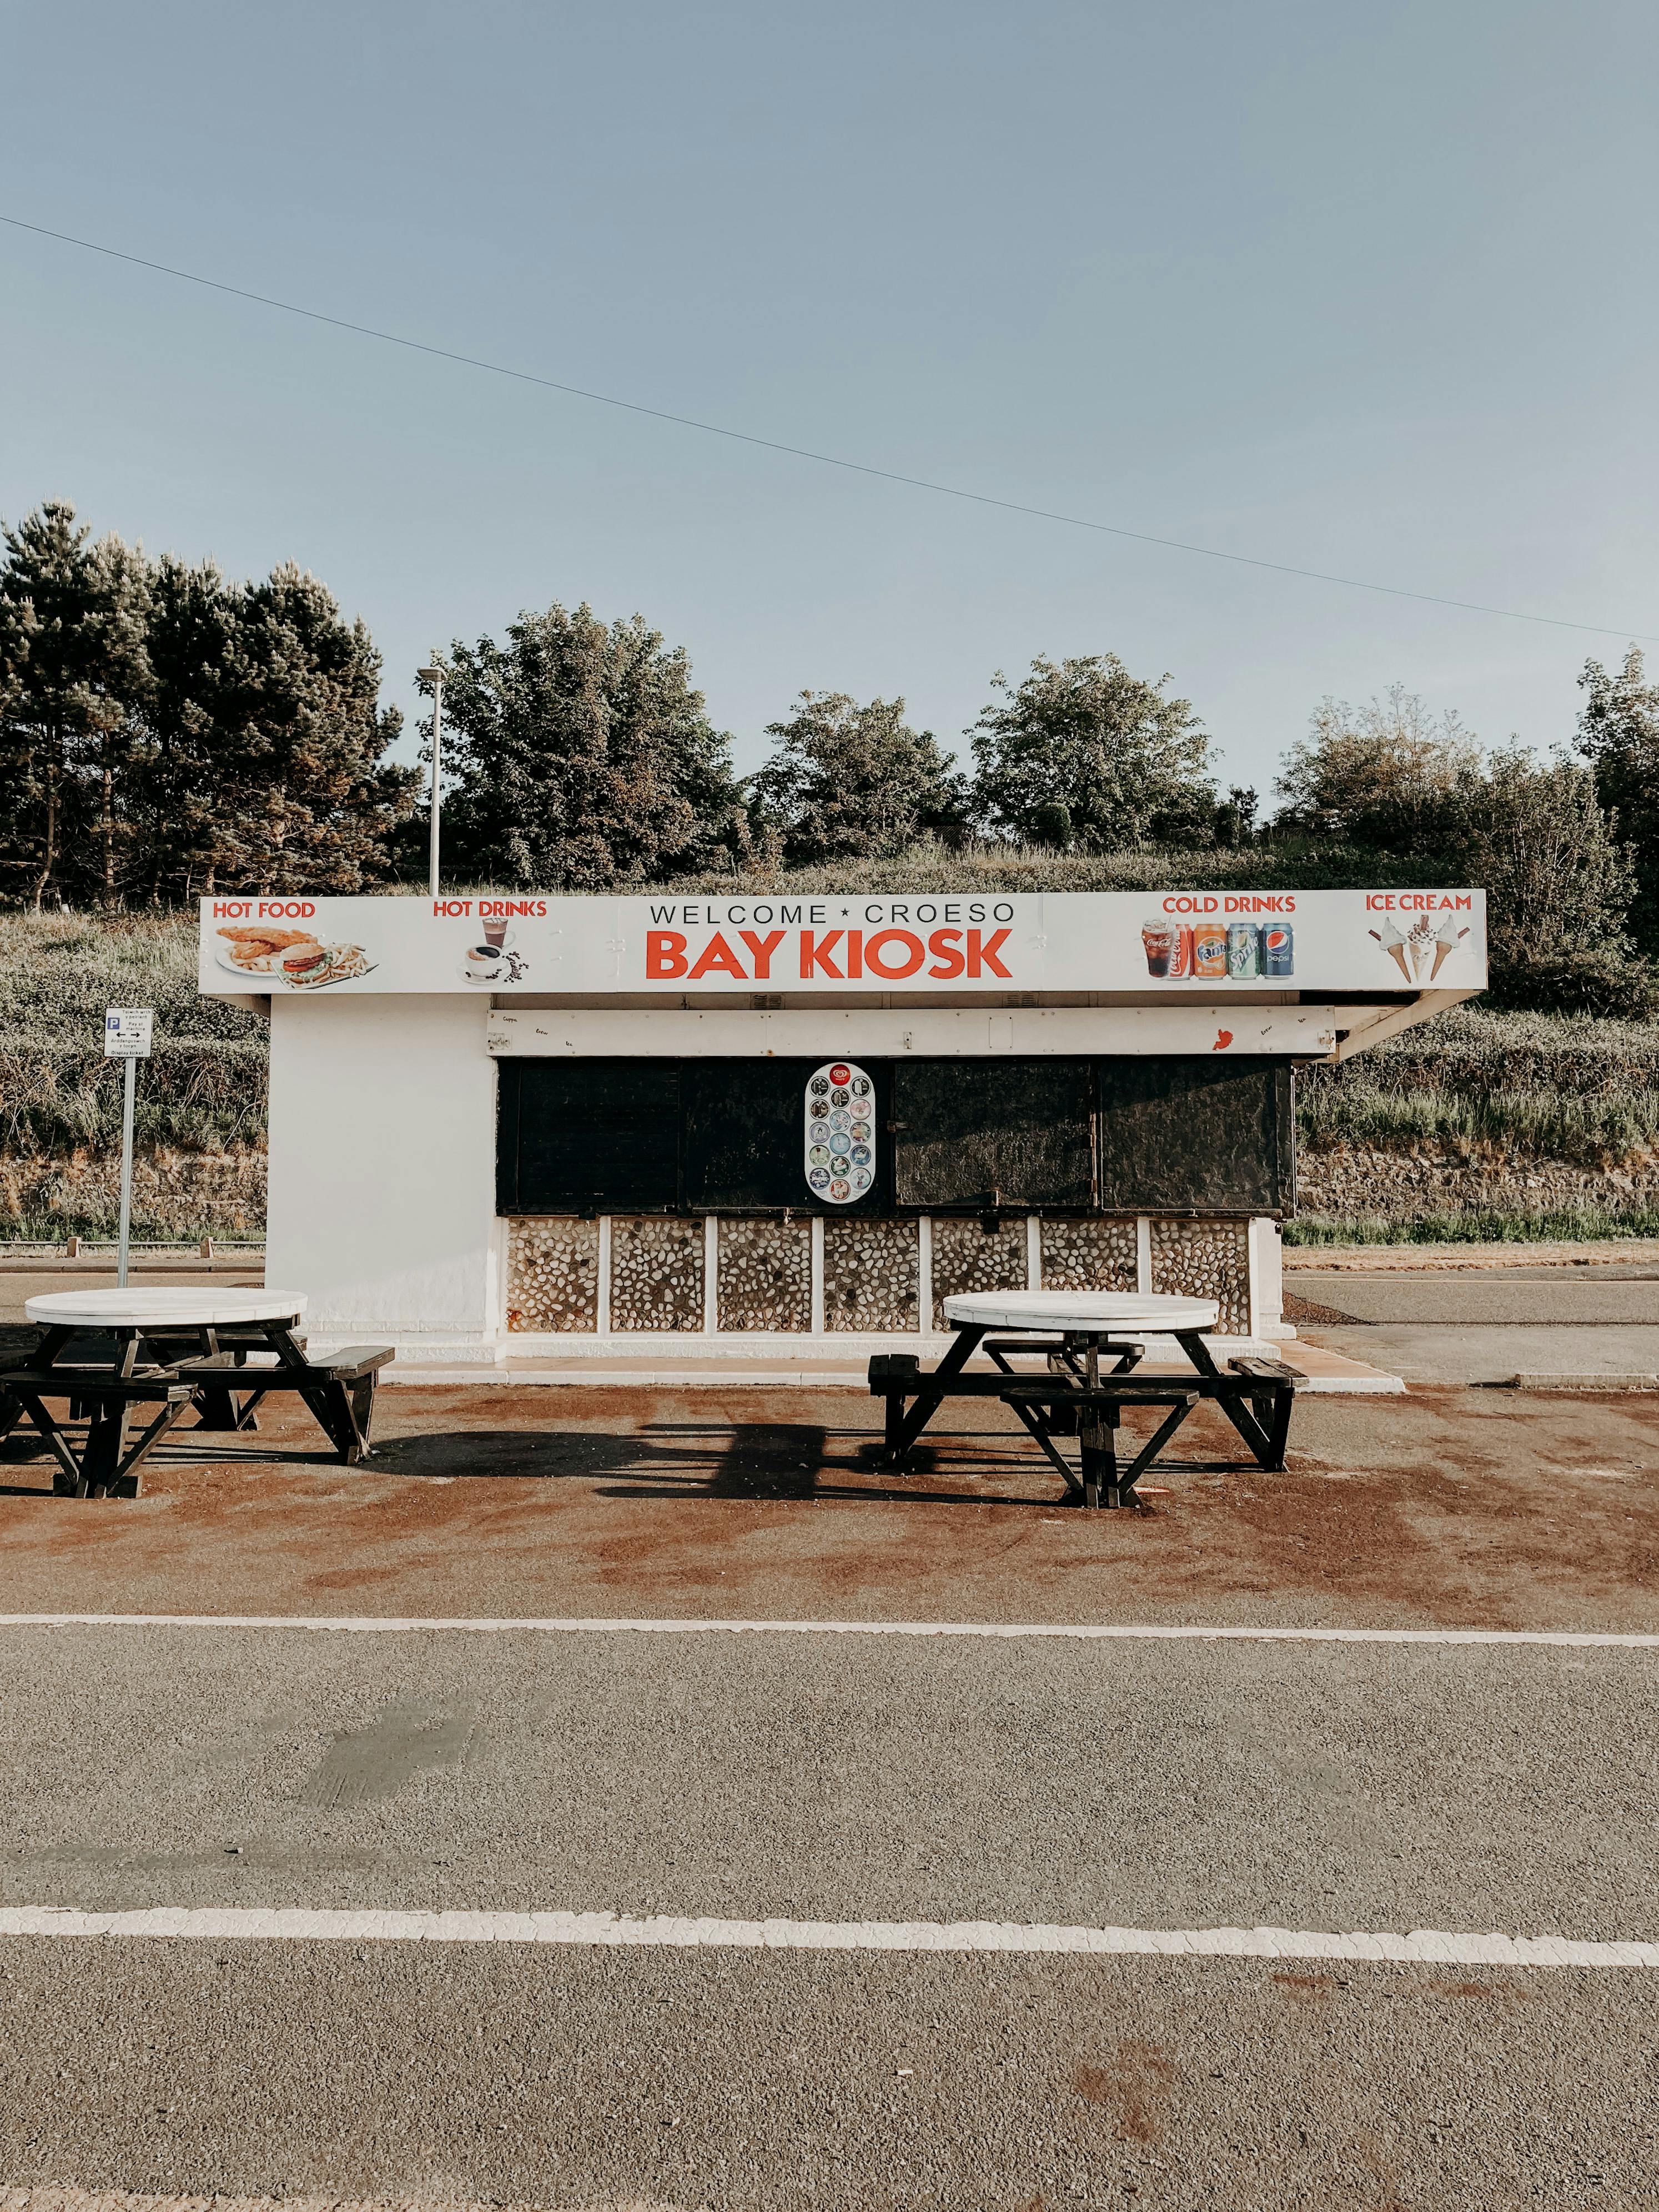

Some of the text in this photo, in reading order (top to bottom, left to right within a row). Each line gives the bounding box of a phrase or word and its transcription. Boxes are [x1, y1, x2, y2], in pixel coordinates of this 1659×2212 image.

[213, 902, 315, 918] HOT FOOD
[434, 901, 546, 917] HOT DRINKS
[1163, 896, 1295, 913] COLD DRINKS
[1366, 894, 1471, 911] ICE CREAM
[651, 903, 1014, 924] WELCOME CROESO
[646, 929, 1013, 979] BAY KIOSK
[1197, 943, 1226, 961] Fanta
[1230, 936, 1259, 971] Sprite
